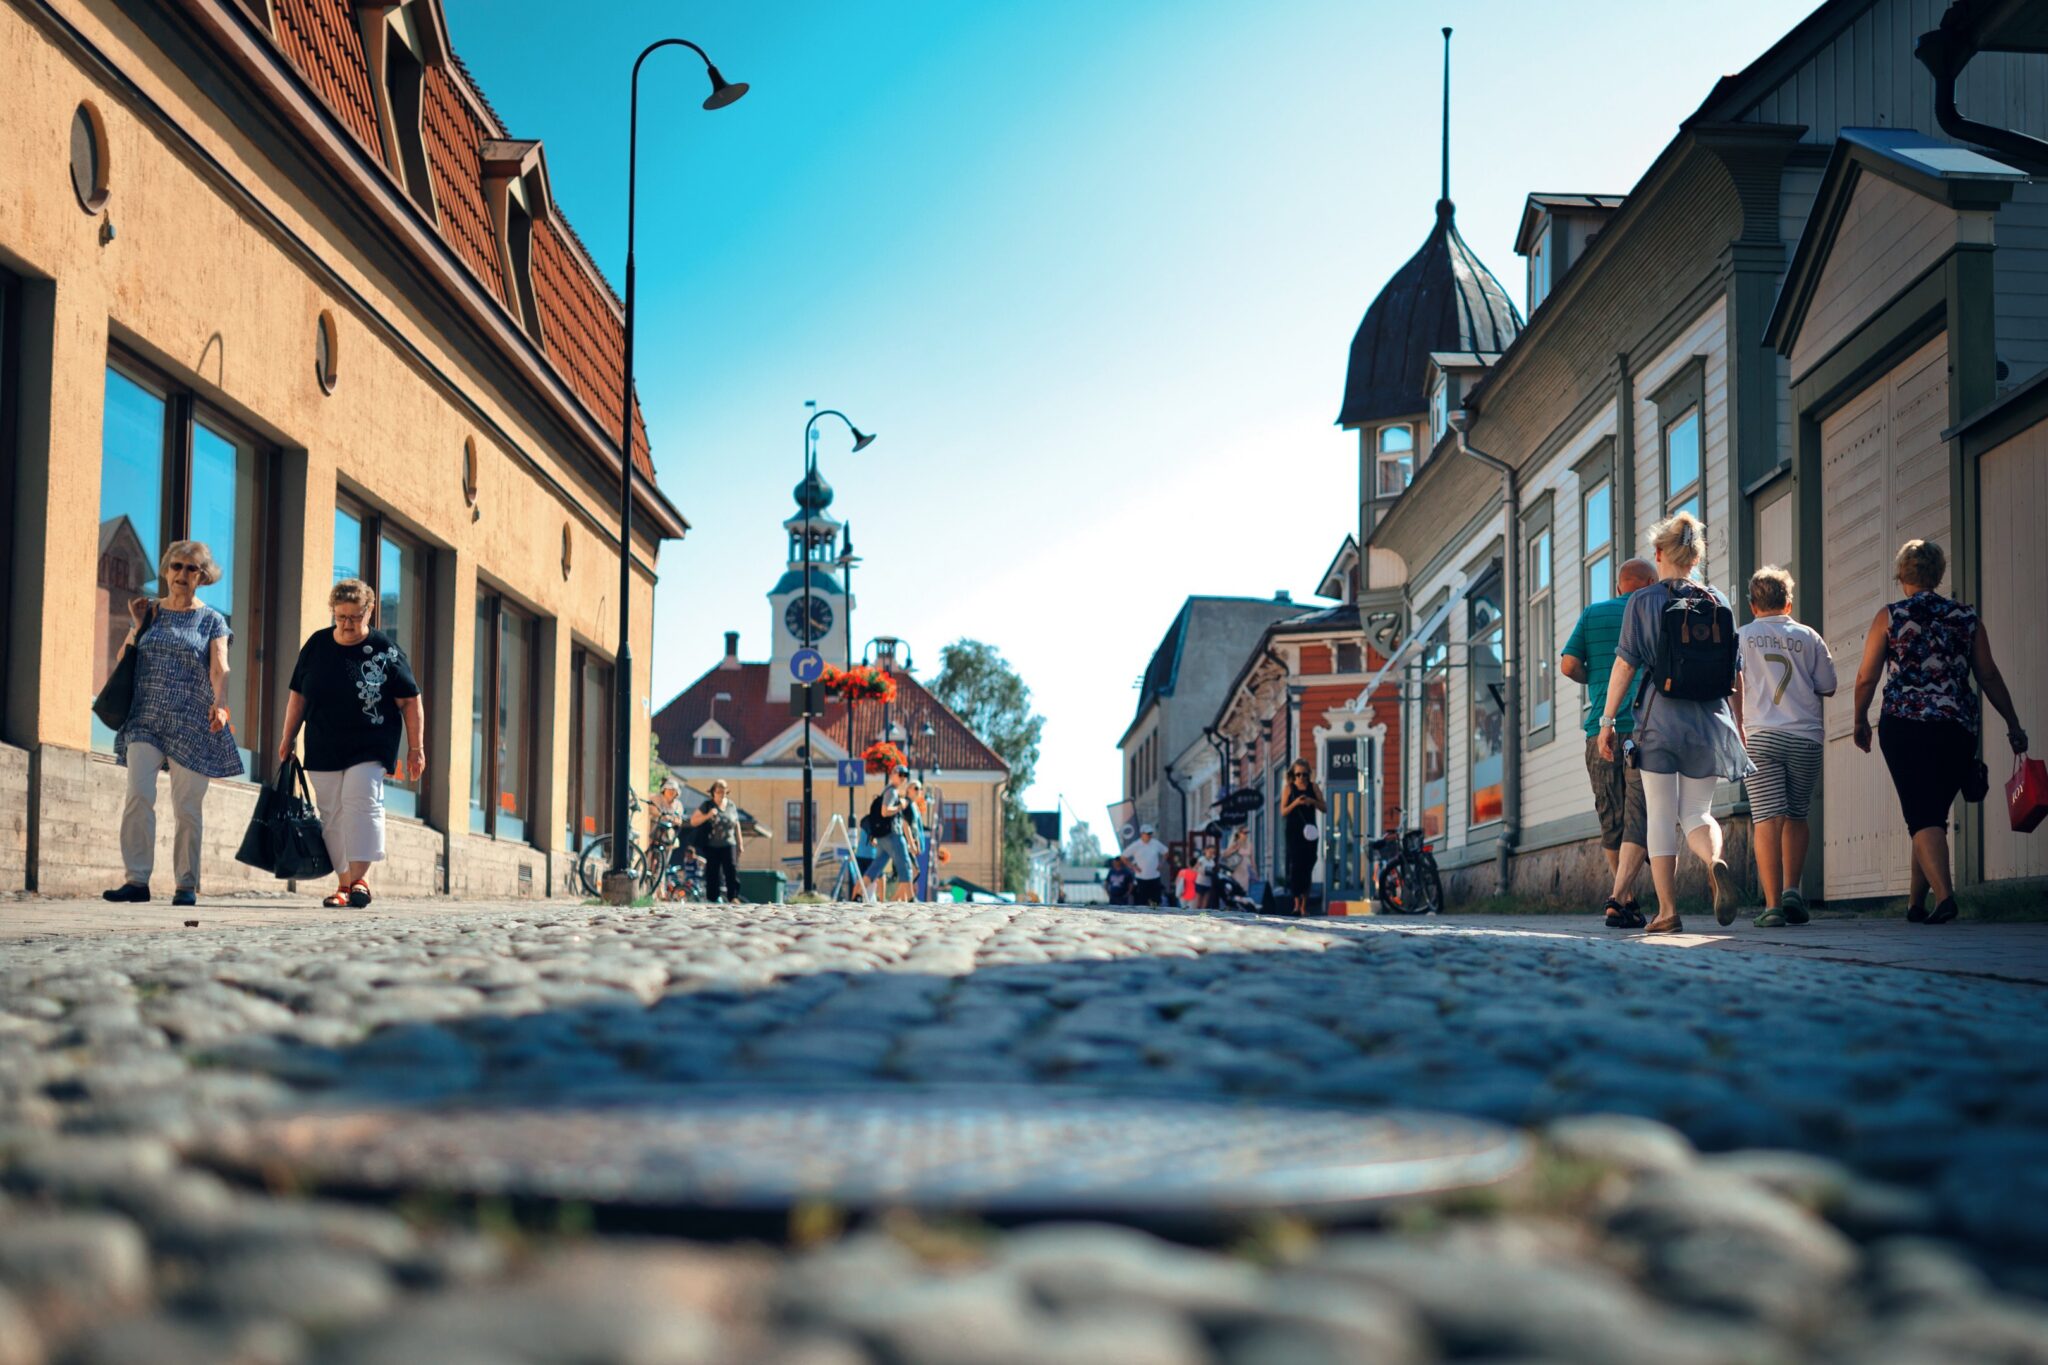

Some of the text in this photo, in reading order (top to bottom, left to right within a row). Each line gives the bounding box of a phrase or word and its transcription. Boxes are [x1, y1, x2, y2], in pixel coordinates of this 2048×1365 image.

[1747, 635, 1803, 653] RONALDO
[1763, 653, 1793, 705] 7
[2012, 780, 2025, 804] JOY
